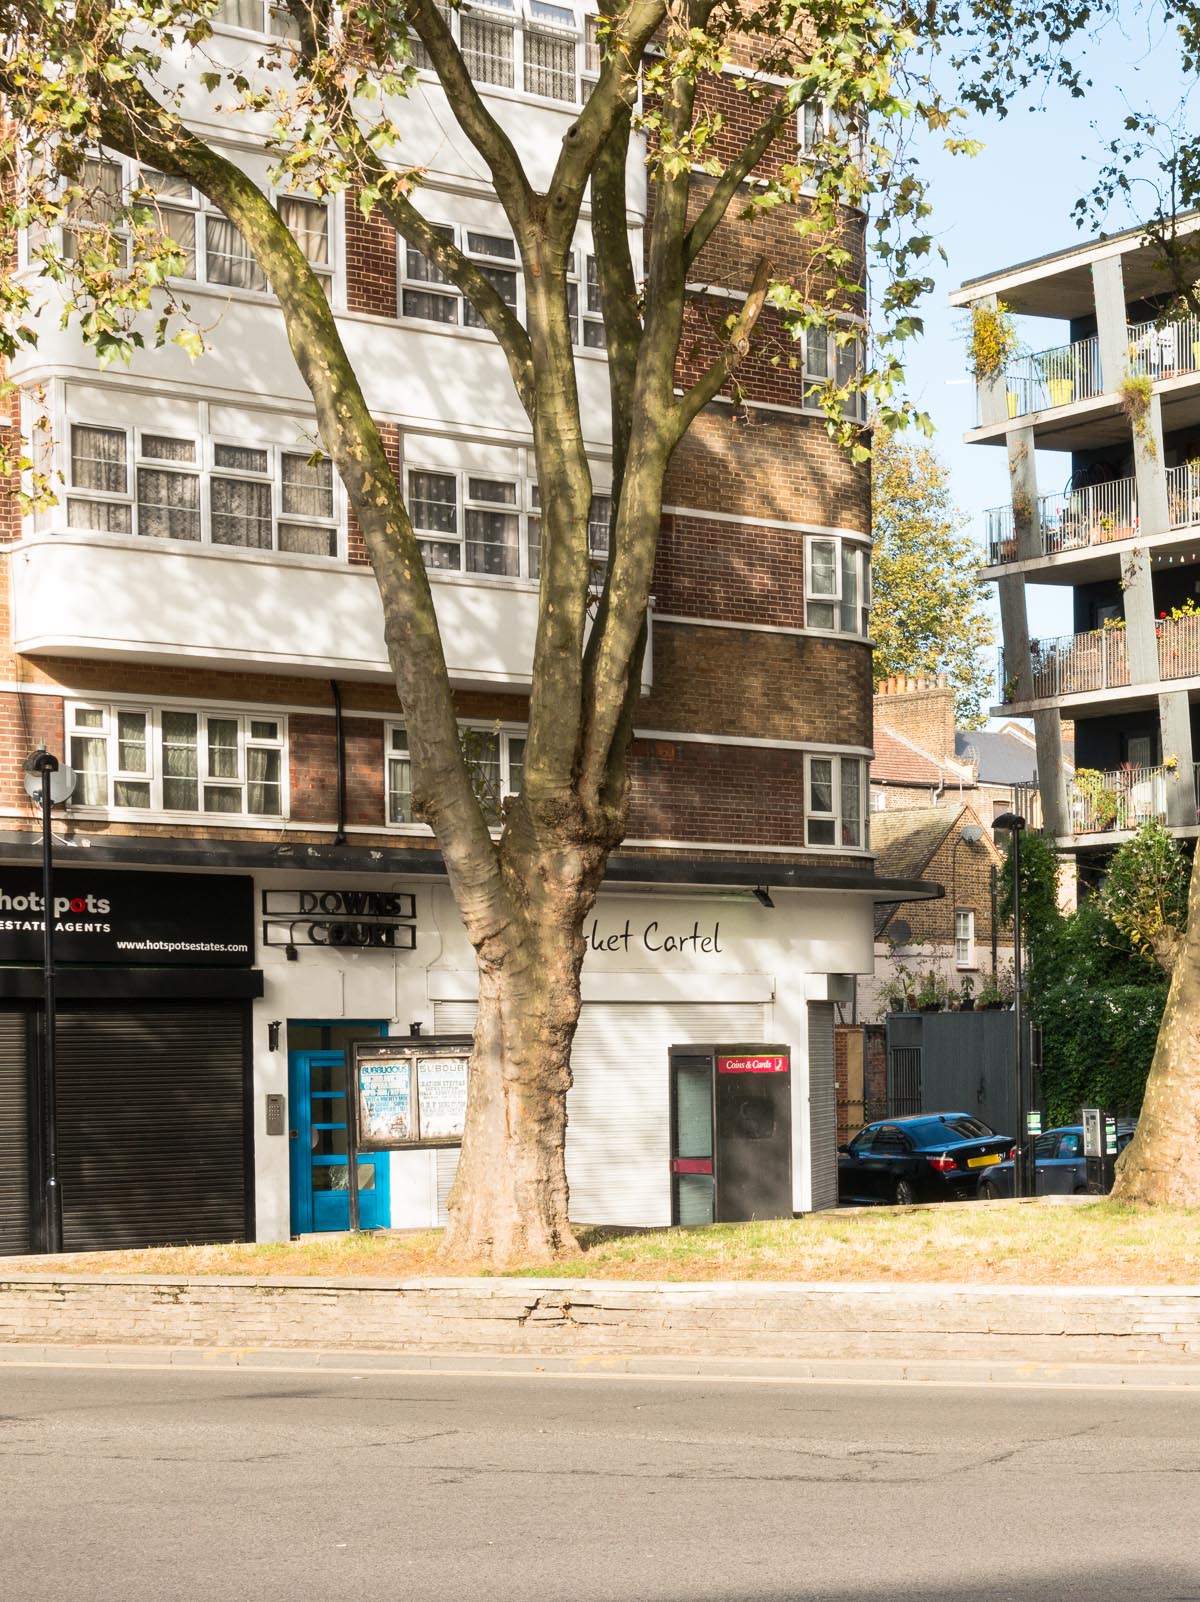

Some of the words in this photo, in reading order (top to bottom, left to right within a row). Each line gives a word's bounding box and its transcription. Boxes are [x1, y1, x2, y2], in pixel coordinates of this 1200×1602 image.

[299, 892, 402, 915] DOWNS
[54, 922, 111, 932] AGENTS
[308, 921, 400, 946] COURT
[116, 939, 248, 953] www.hotspotsestates.com
[643, 921, 723, 953] Cartel
[726, 1060, 745, 1070] Coins
[752, 1060, 772, 1069] Cards
